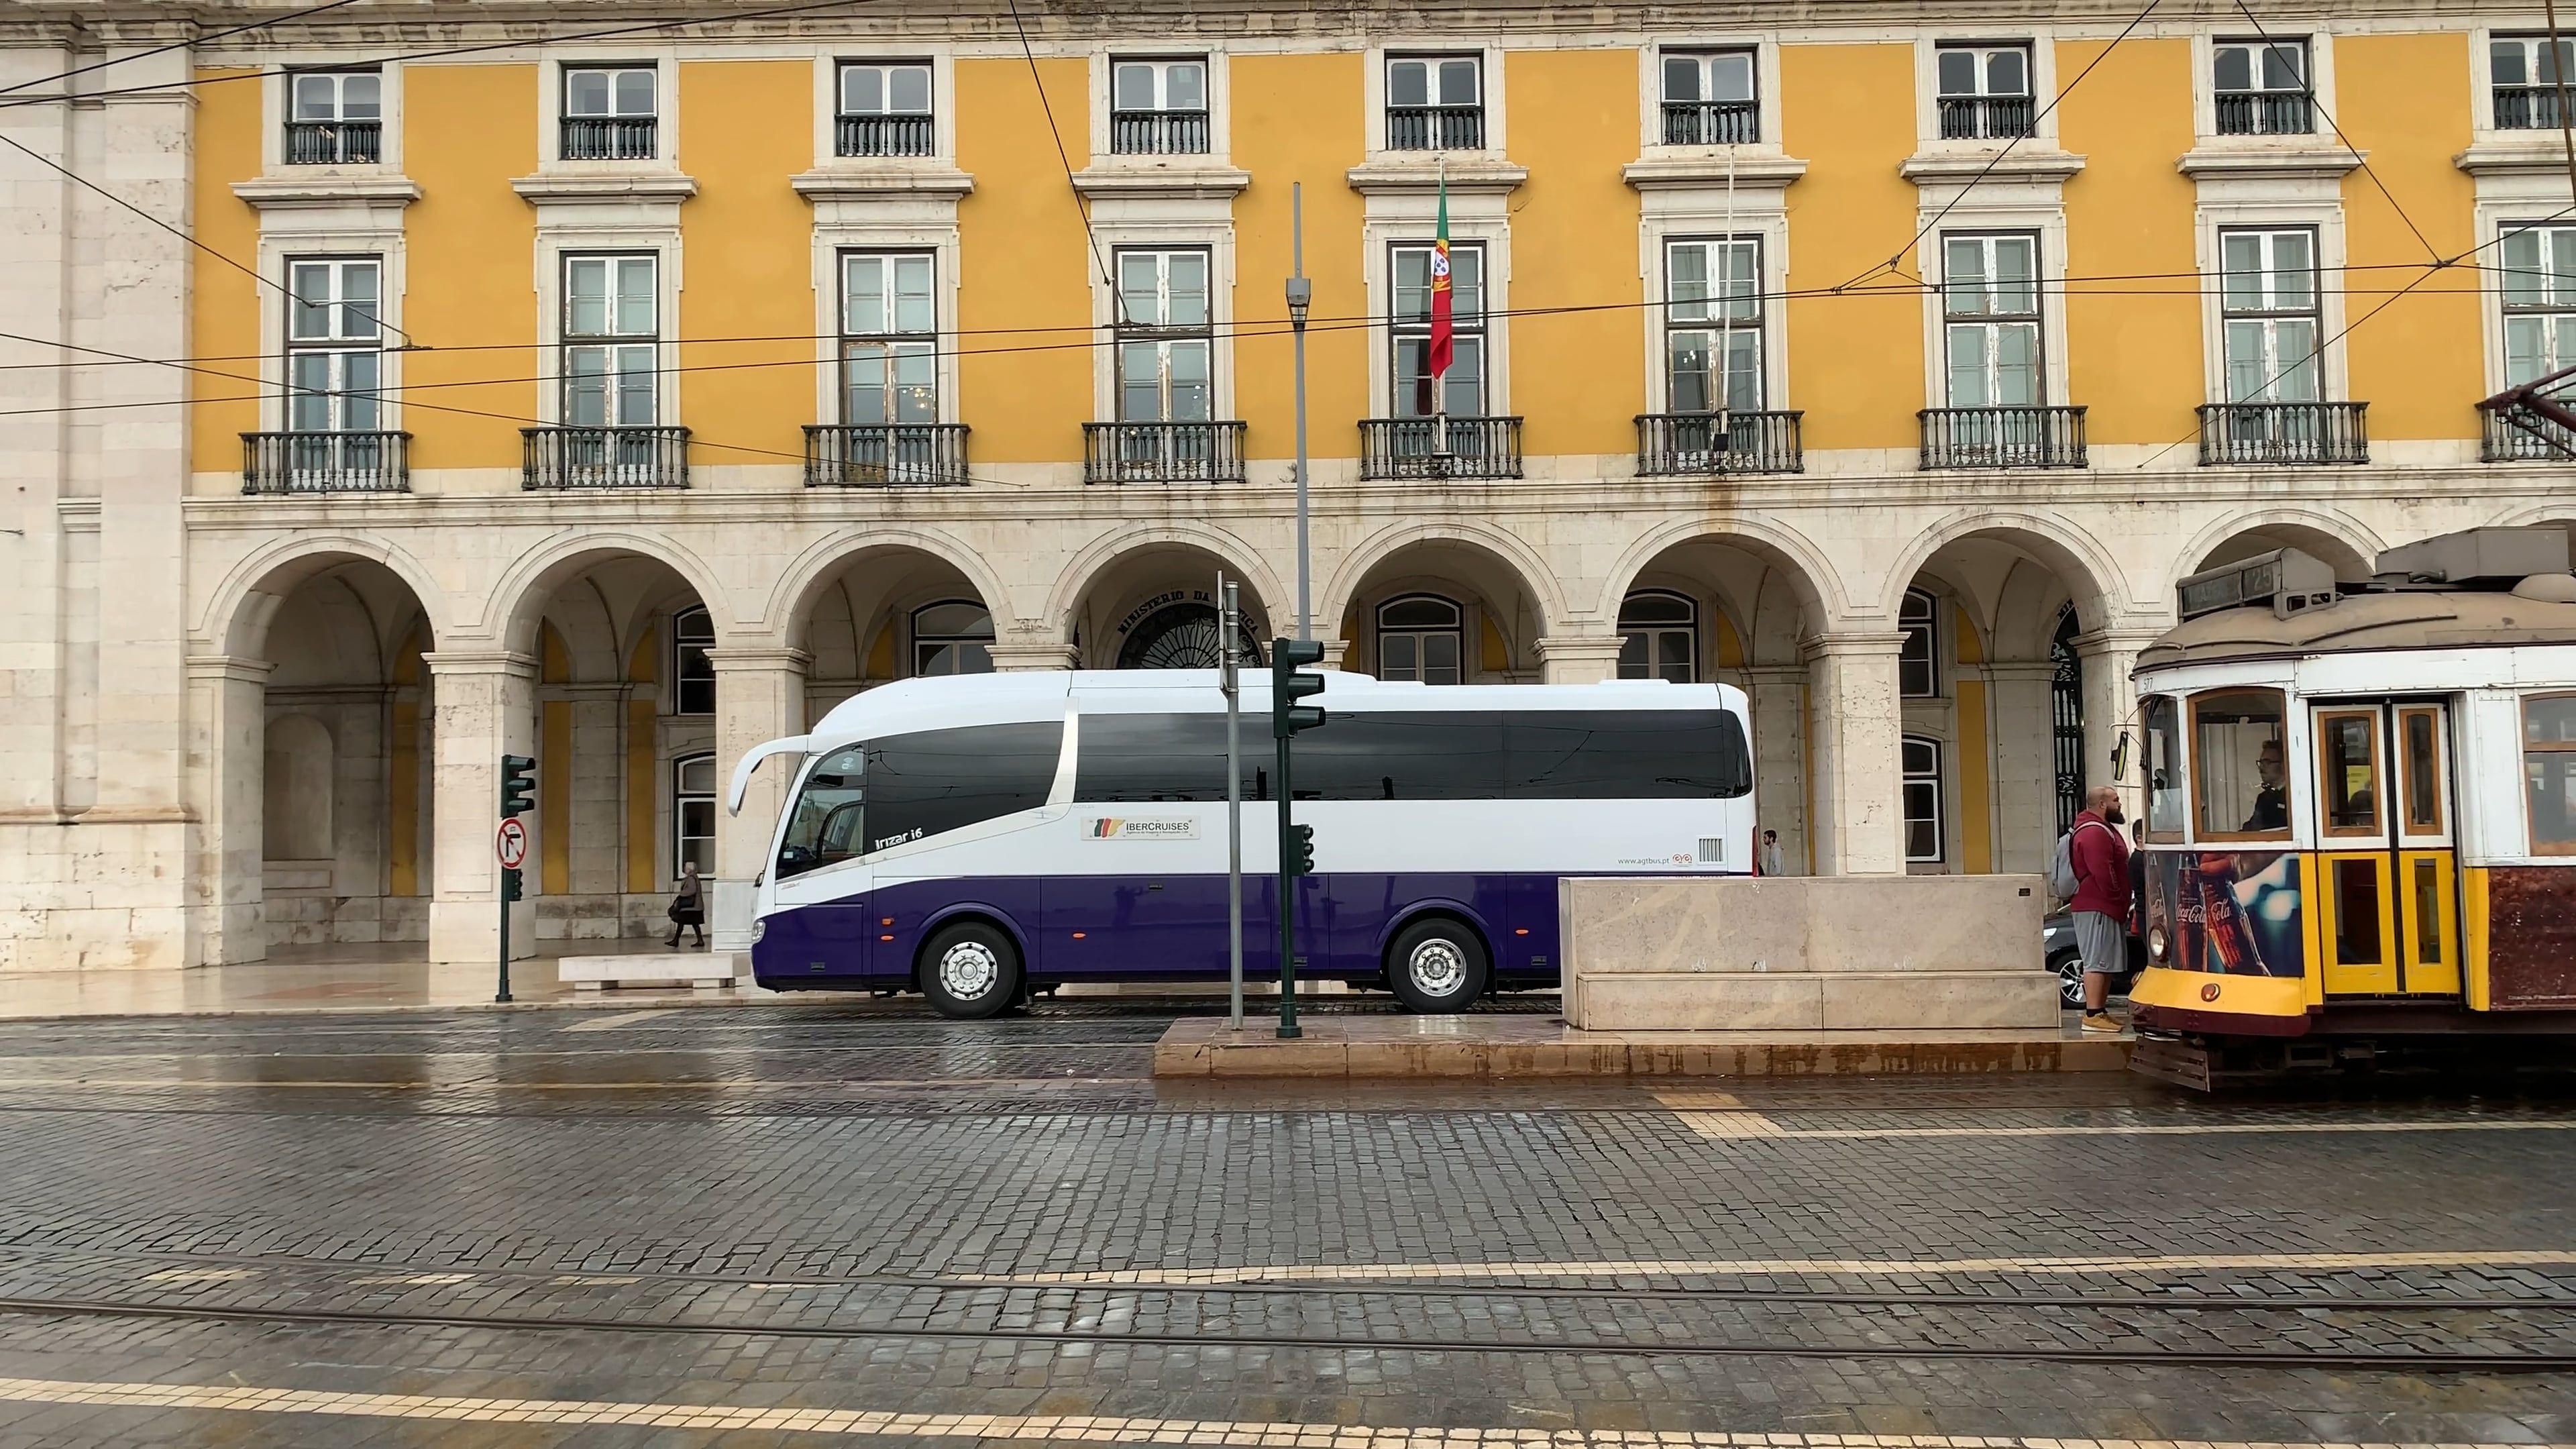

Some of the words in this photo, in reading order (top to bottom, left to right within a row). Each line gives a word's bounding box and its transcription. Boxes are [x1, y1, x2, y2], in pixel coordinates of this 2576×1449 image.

[1193, 590, 1210, 601] DA
[1126, 822, 1189, 830] IBERCRUISES
[910, 827, 923, 840] i6
[1617, 857, 1670, 865] www.agtbus.pt
